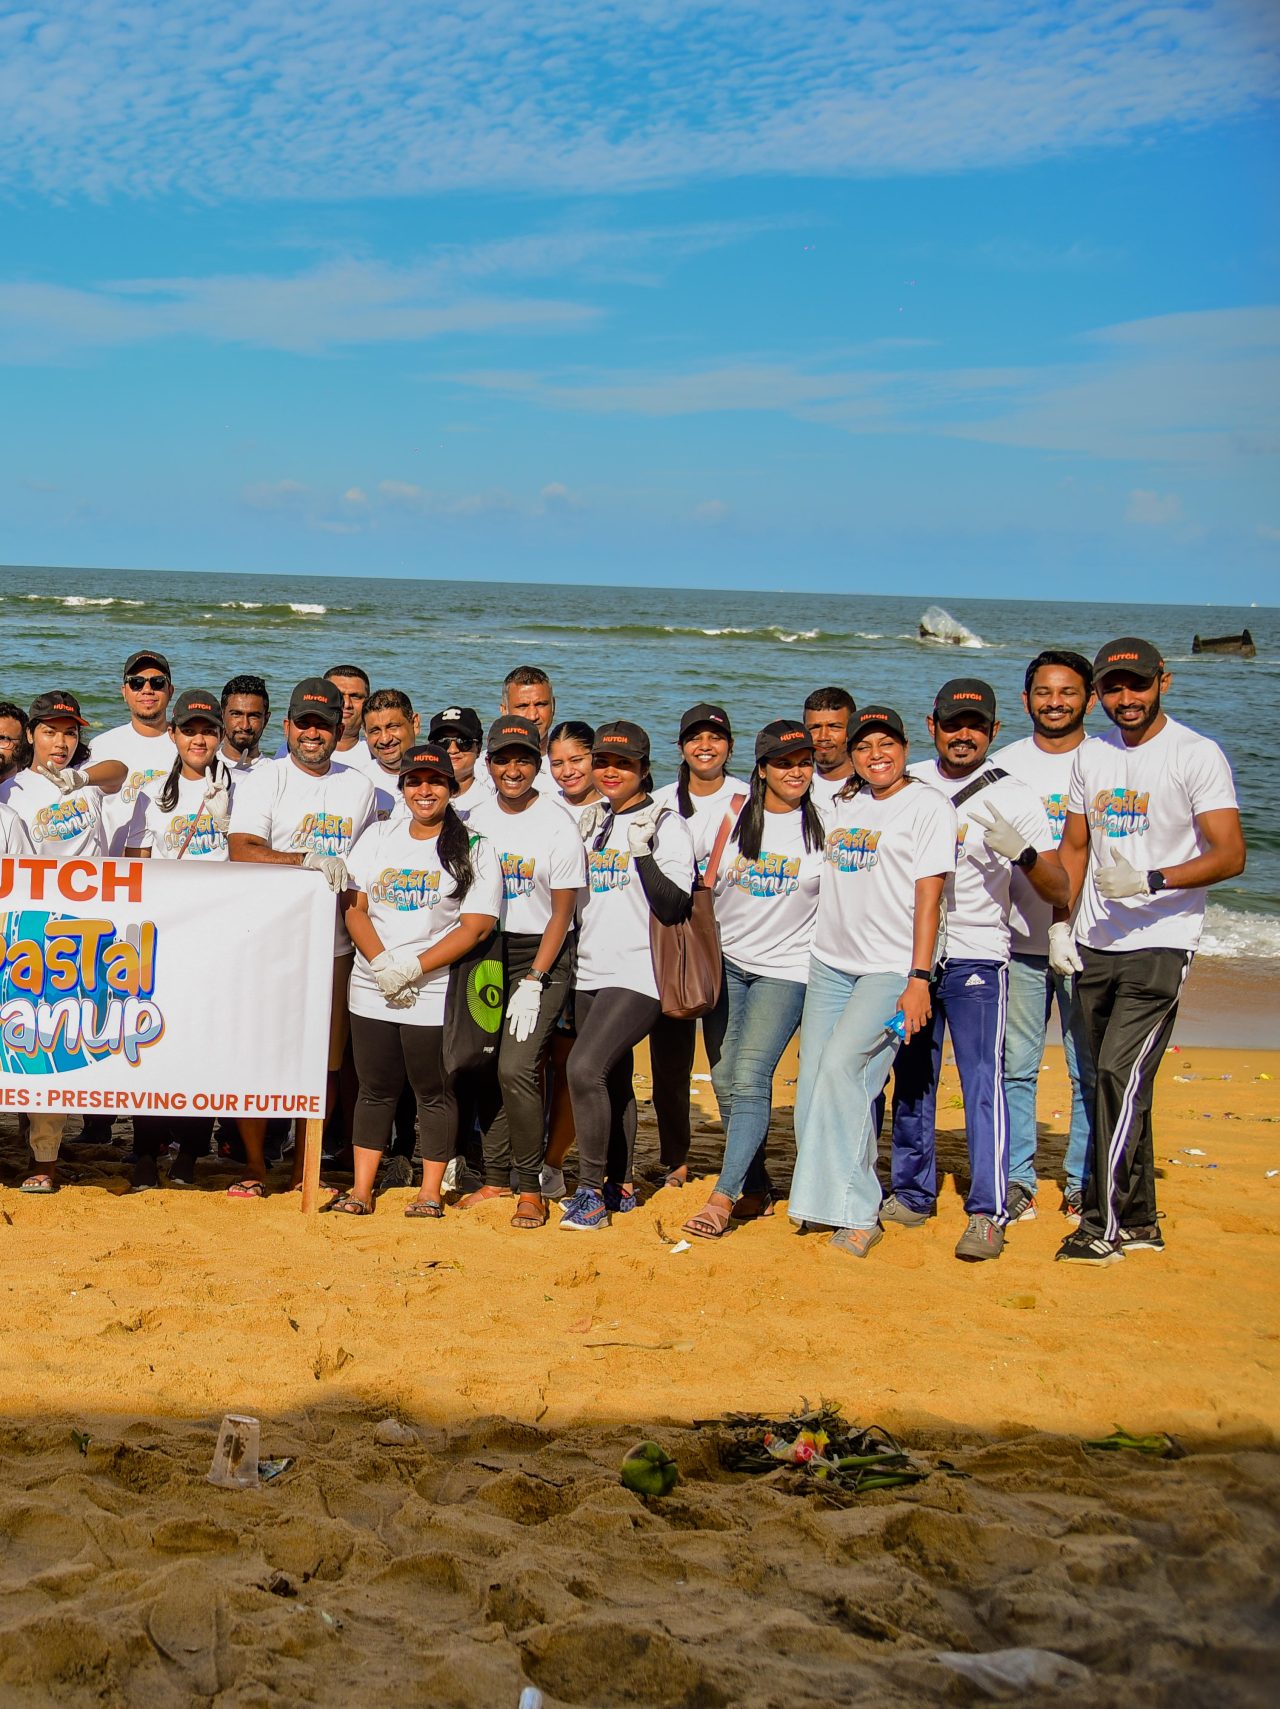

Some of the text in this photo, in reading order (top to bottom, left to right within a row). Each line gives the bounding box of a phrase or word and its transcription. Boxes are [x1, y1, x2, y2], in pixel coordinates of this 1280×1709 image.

[1107, 652, 1139, 663] HUTCH
[303, 694, 329, 704] HUTCH
[953, 693, 983, 702] HUTCH
[188, 703, 212, 711] HUTCH
[860, 713, 888, 722] HUTCH
[502, 727, 529, 736] HUTCH
[602, 736, 629, 744] HUTCH
[780, 732, 805, 742] HUTCH
[414, 754, 439, 762] HUTCH
[47, 1089, 187, 1110] PRESERVING
[192, 1092, 237, 1112] OUR
[244, 1094, 320, 1113] FUTURE
